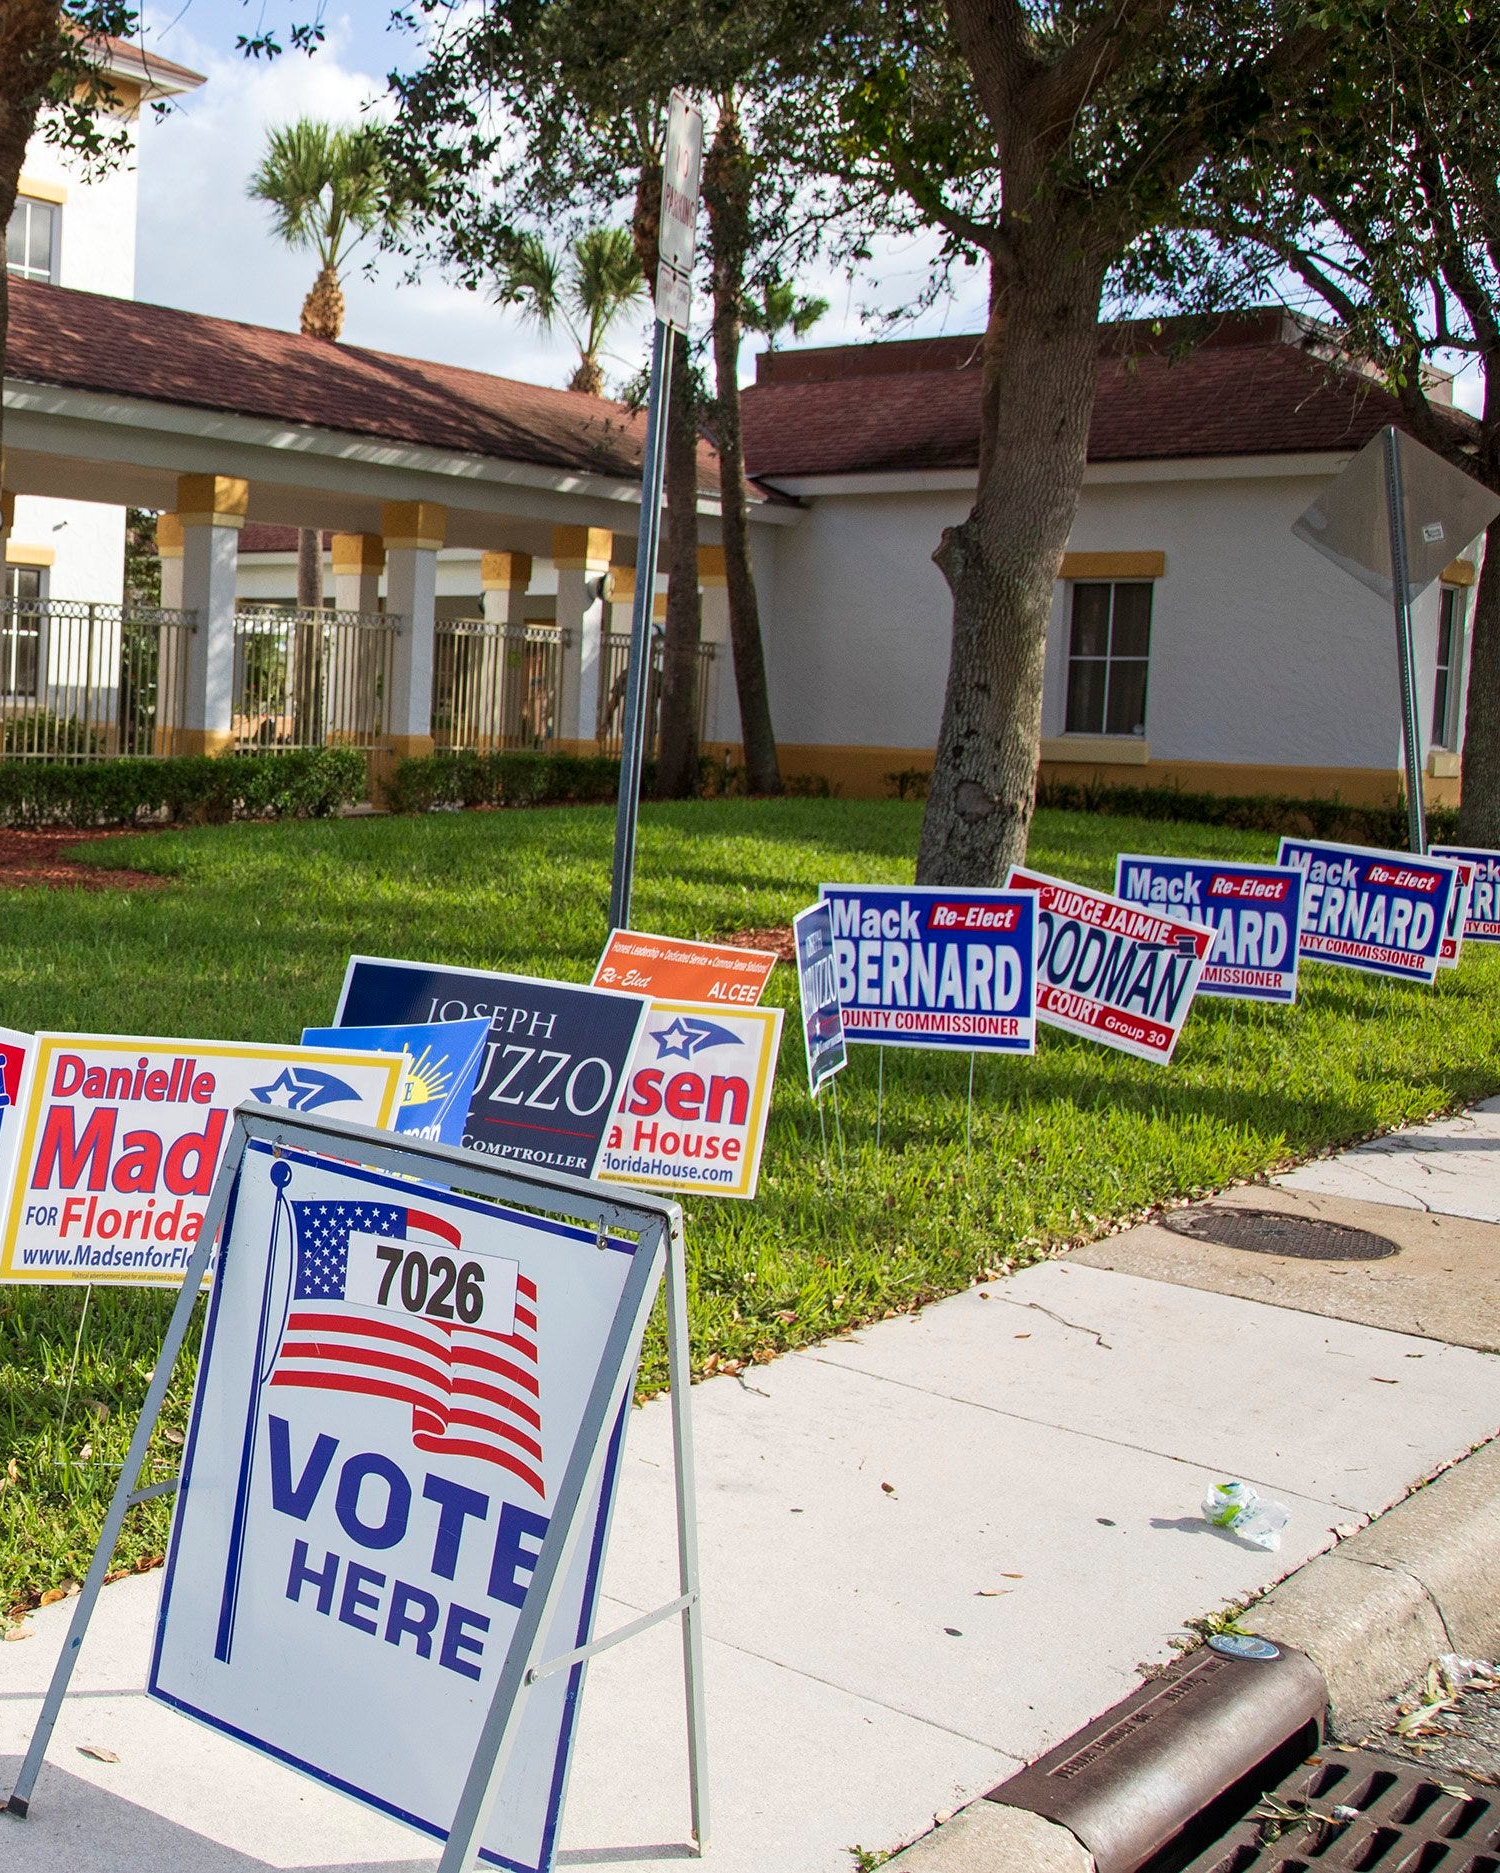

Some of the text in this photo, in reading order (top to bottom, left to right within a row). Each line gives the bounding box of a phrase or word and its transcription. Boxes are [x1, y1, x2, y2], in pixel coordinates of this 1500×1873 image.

[1126, 867, 1284, 905] Mack Re-Elect
[1288, 850, 1436, 891] Mack Re-Elect
[833, 899, 1014, 940] Mack Re-Elect
[1048, 890, 1172, 944] JUDGE JAIMIE
[613, 942, 632, 955] Honest
[631, 945, 660, 960] Leadership
[664, 950, 691, 965] Dedicated
[689, 953, 708, 966] Service
[1325, 938, 1425, 969] COMMISSIONER
[600, 967, 653, 988] Re-Elect
[707, 982, 759, 1003] ALCEE
[835, 939, 1022, 1012] BERNARD
[1201, 967, 1282, 988] MISSIONER
[427, 998, 558, 1039] JOSEPH
[895, 1013, 1019, 1036] COMMISSIONER
[1047, 991, 1104, 1025] COURT
[1104, 1017, 1145, 1040] Group
[1146, 1030, 1166, 1046] 30
[52, 1054, 216, 1104] Danielle
[633, 1120, 741, 1162] House
[603, 1152, 733, 1182] loridaHouse.com
[25, 1196, 204, 1242] FOR Florida
[23, 1245, 192, 1269] www.MadsenforFl
[375, 1244, 485, 1325] 7026
[267, 1413, 550, 1610] VOTE
[284, 1538, 492, 1683] HERE
